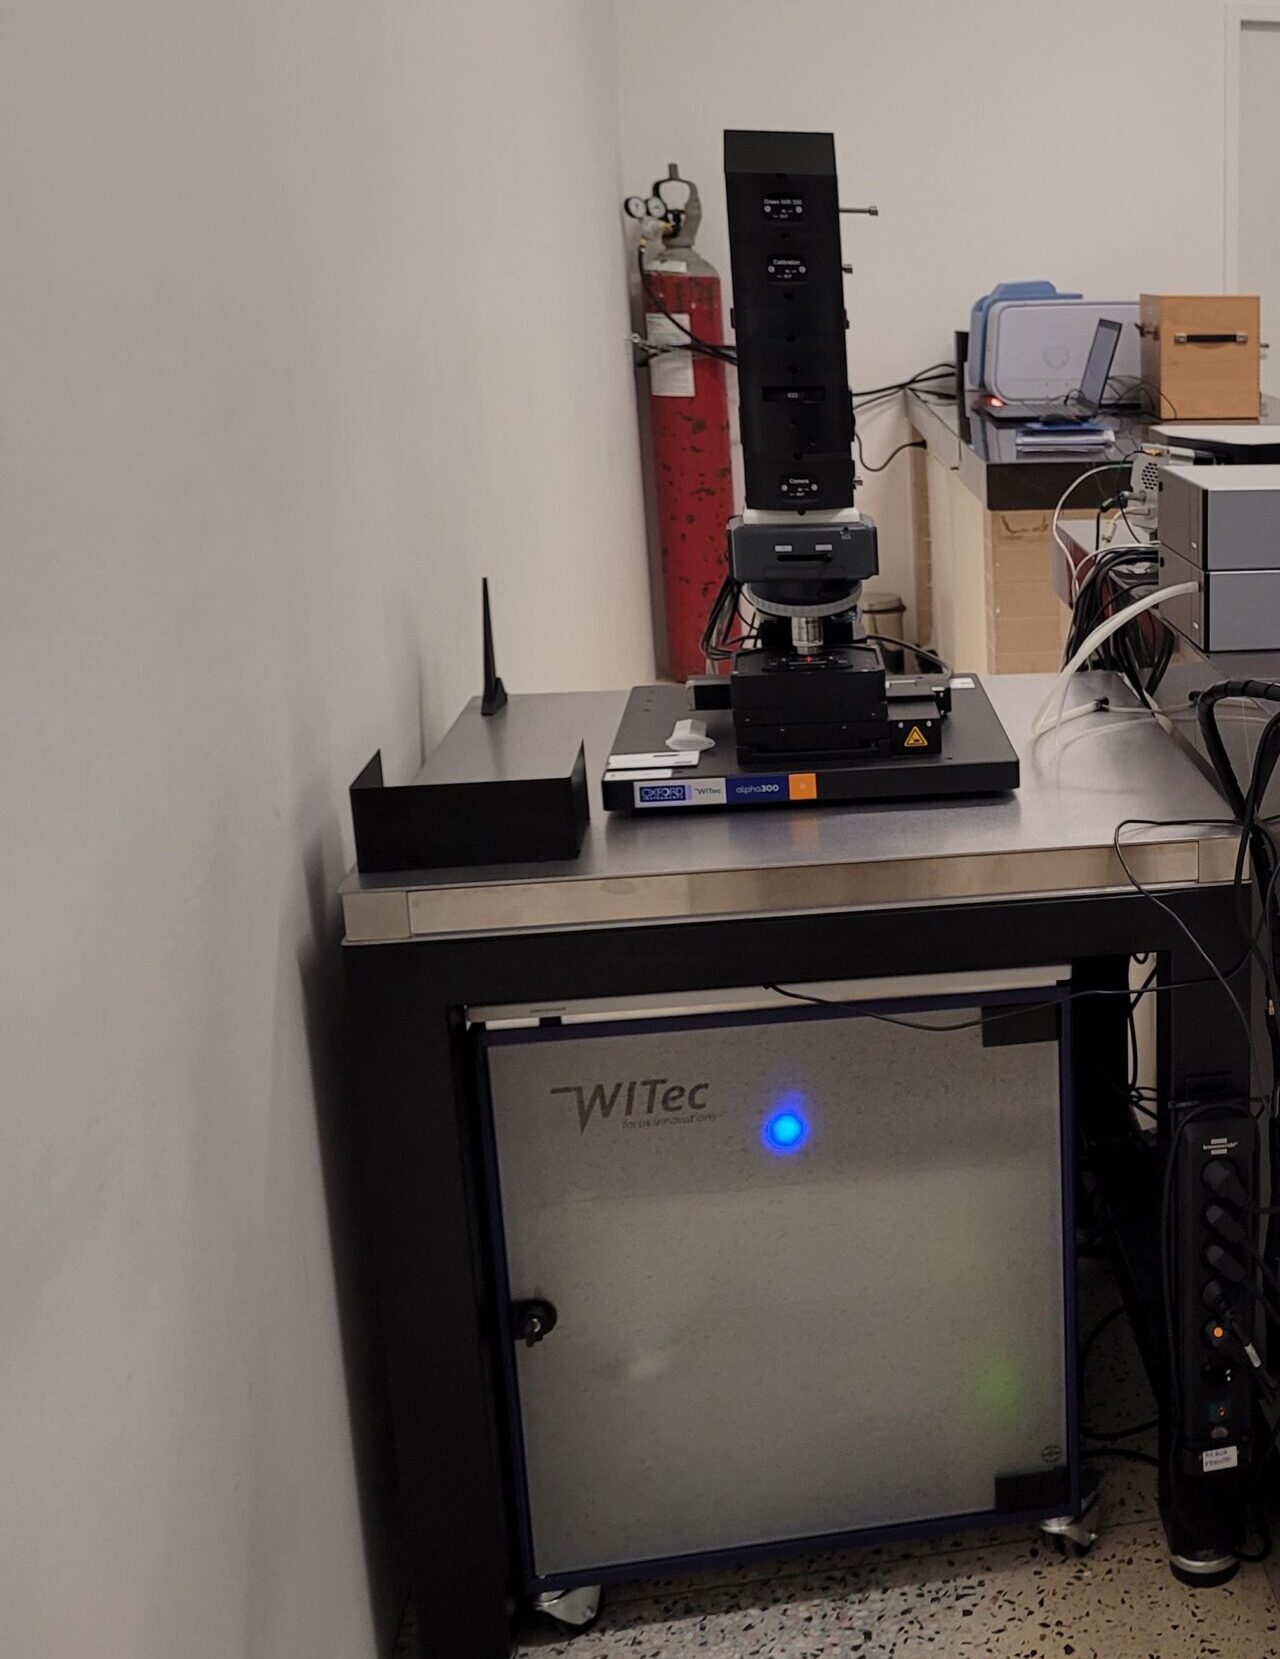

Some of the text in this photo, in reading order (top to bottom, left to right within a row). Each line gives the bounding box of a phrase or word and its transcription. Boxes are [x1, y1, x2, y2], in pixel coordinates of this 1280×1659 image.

[641, 787, 684, 796] OXFORD
[694, 787, 721, 796] WITec
[735, 784, 780, 795] alpha300
[550, 1078, 709, 1135] WITec
